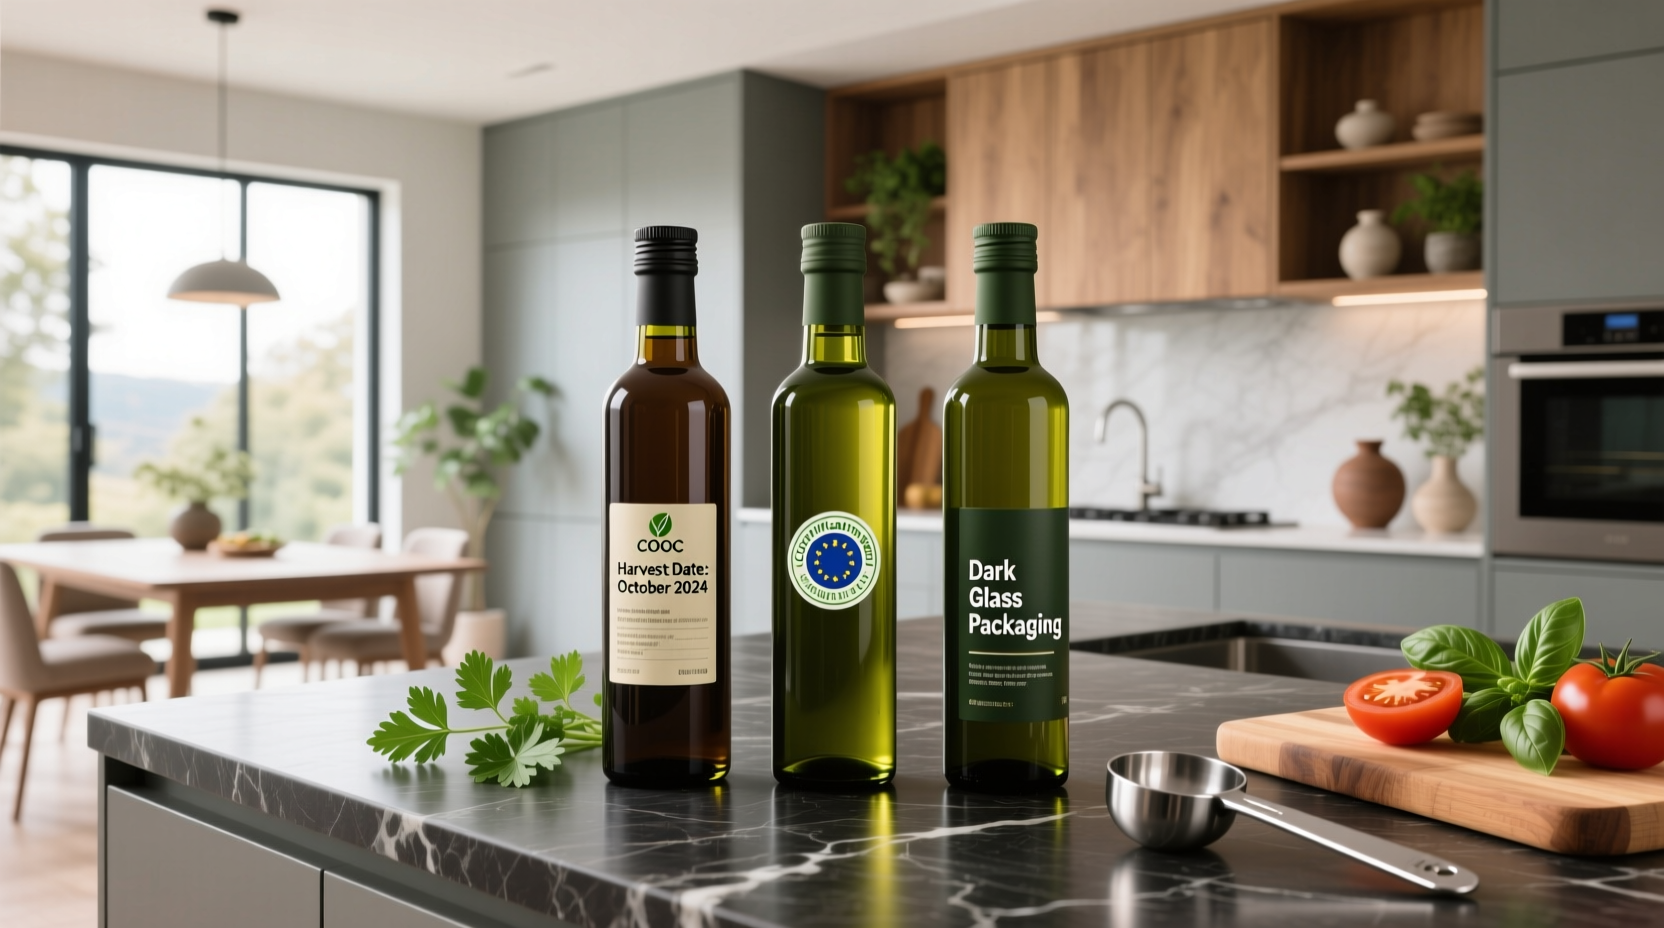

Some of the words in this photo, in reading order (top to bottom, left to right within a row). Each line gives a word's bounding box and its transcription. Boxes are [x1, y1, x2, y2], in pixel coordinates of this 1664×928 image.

[637, 539, 684, 553] COOC
[617, 562, 670, 576] Harvest
[672, 562, 709, 576] Date:
[969, 559, 1017, 581] Dark
[617, 580, 671, 594] October
[674, 580, 708, 594] 2024
[969, 586, 1023, 608] Glass
[968, 613, 1062, 641] Packaging
